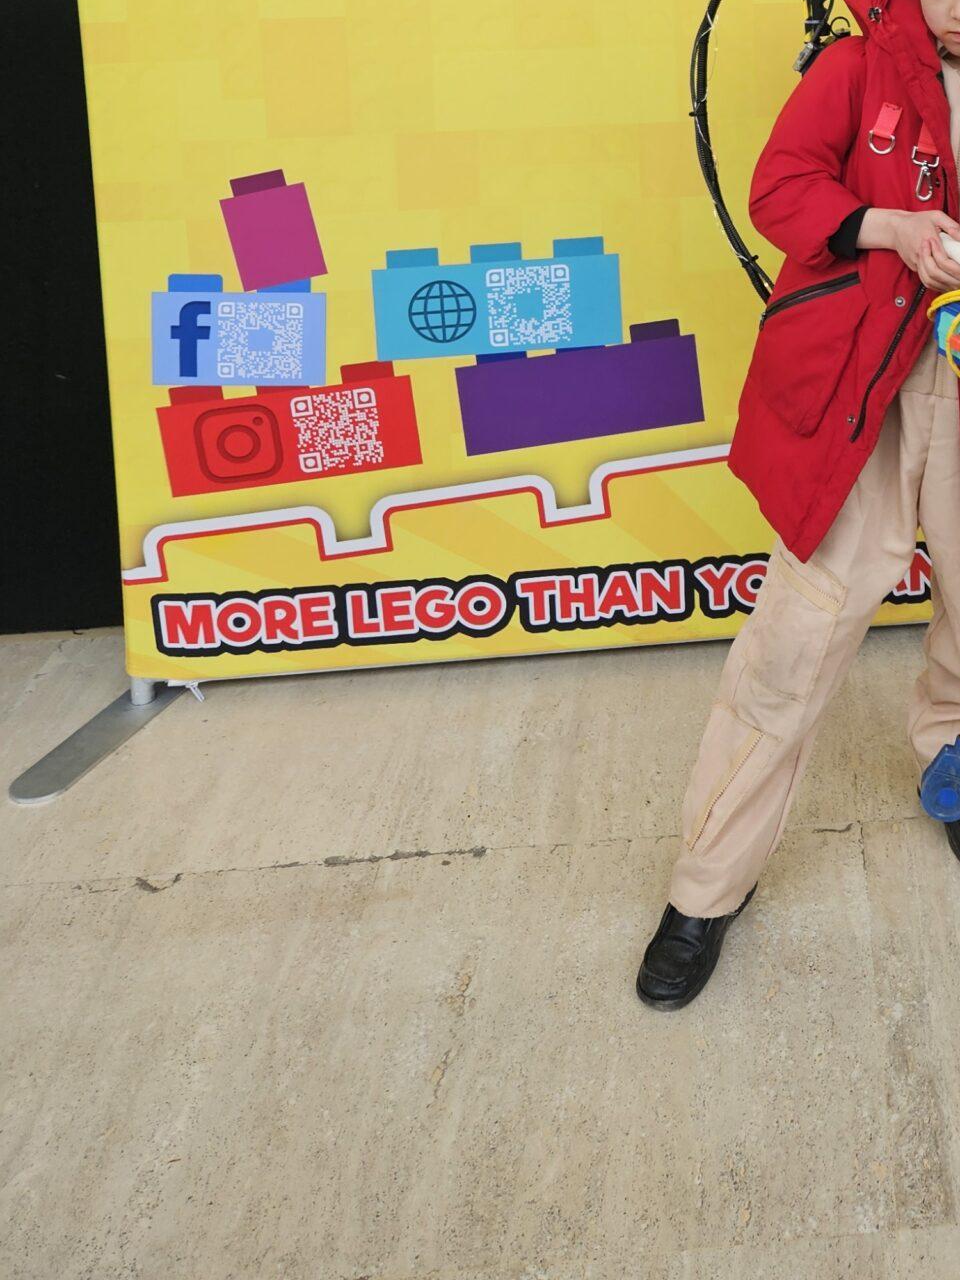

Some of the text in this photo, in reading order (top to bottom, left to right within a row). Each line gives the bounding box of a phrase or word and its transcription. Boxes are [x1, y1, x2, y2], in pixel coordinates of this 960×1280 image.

[157, 592, 336, 648] MORE
[347, 581, 506, 640] LEGO
[517, 565, 685, 624] THAN
[693, 560, 769, 611] YO
